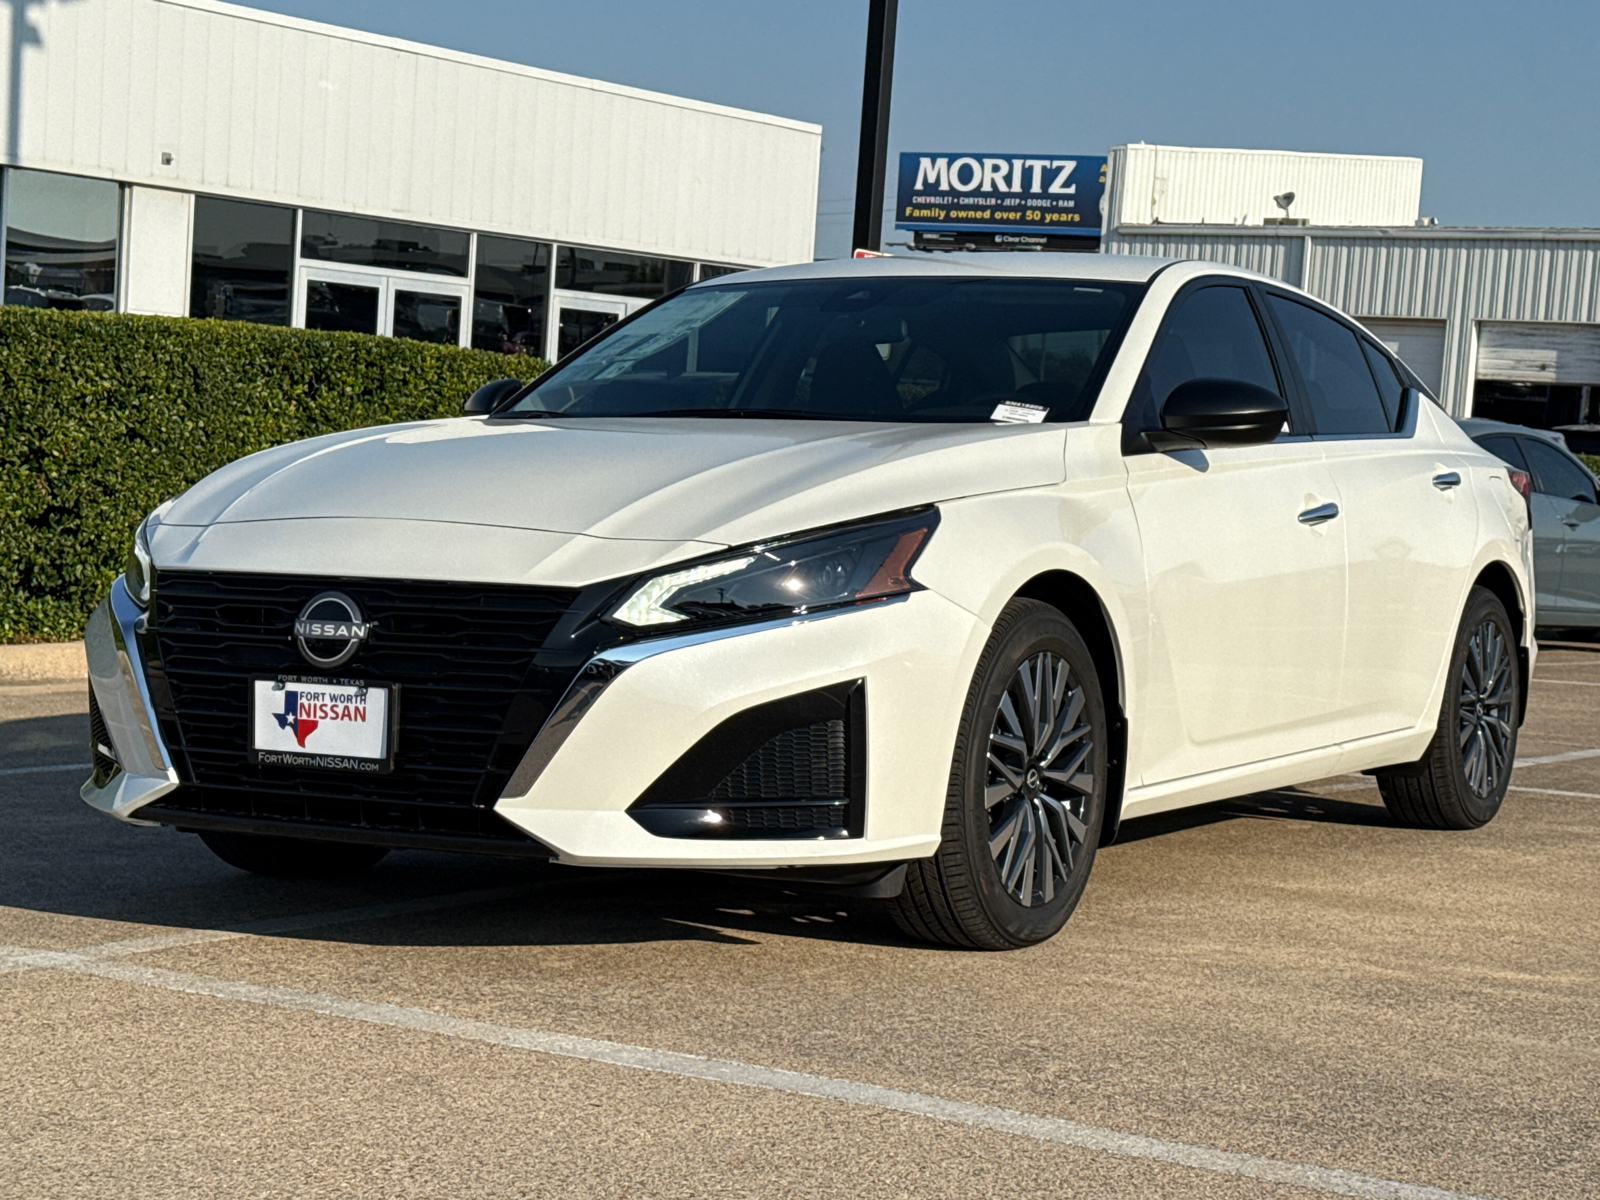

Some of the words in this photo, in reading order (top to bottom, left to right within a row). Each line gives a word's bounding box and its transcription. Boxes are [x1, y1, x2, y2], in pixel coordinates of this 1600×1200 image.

[914, 157, 1077, 194] MORITZ
[912, 196, 953, 204] CHEVROLET
[959, 197, 996, 206] CHRYSLER
[1003, 198, 1020, 206] JEEP
[1027, 199, 1051, 207] DODGE
[1058, 200, 1075, 208] RAM
[905, 206, 947, 220] Family
[950, 209, 991, 219] owned
[994, 211, 1022, 220] over
[1025, 210, 1041, 221] 50
[1044, 212, 1080, 224] years
[294, 623, 366, 637] NISSAN
[300, 676, 328, 684] WORTH
[340, 678, 365, 686] TEXAS
[299, 691, 327, 702] FORT
[328, 693, 367, 705] WORTH
[299, 702, 367, 722] NISSAN
